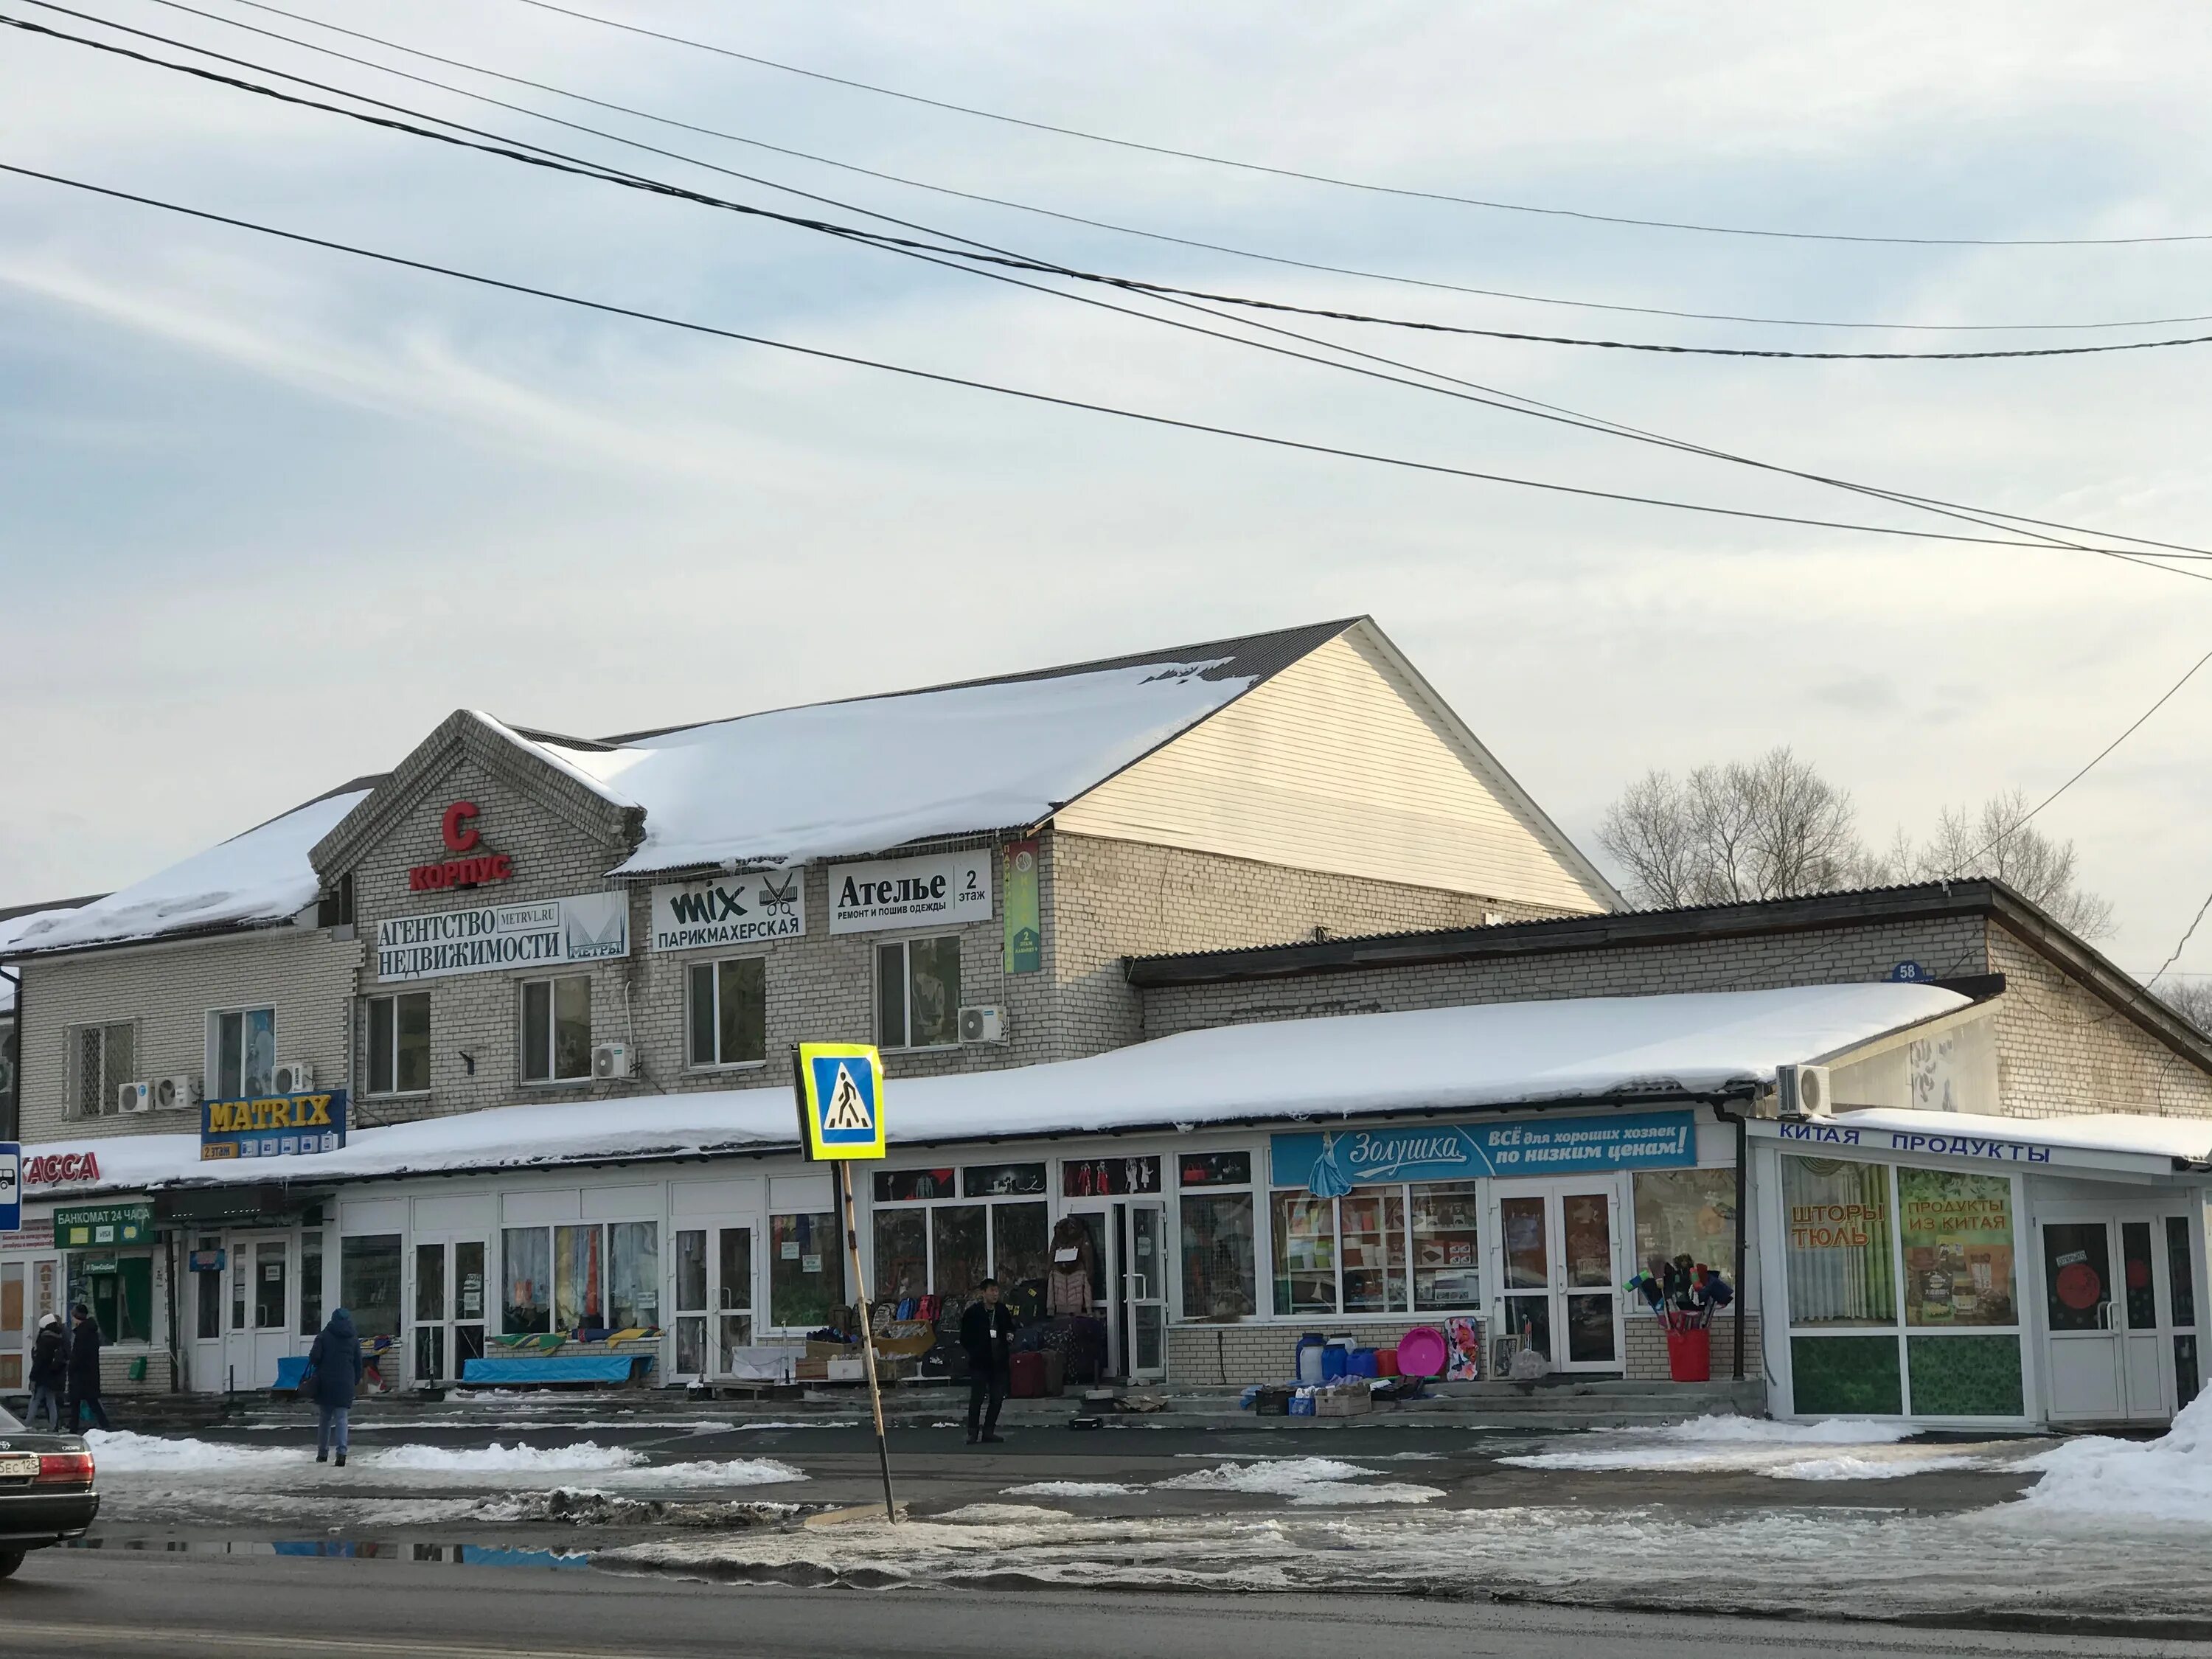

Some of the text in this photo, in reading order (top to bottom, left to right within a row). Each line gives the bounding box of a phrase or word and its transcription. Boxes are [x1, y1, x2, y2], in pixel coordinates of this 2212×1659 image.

[442, 801, 481, 852] С
[409, 855, 512, 891] КОРПУС
[838, 875, 946, 908] Ателье
[959, 870, 985, 902] 2 этаж
[501, 908, 554, 925] METRVL.RU
[838, 902, 946, 919] РЕМОНТ И ПОШИВ ОДЕЖДЫ
[378, 909, 495, 947] АГЕНТСТВО
[658, 917, 799, 948] ПАРИКМАХЕРСКАЯ
[1023, 931, 1029, 940] 2
[378, 932, 560, 978] НЕДВИЖИМОСТИ
[571, 943, 621, 958] МЕТРЫ
[1900, 964, 1916, 978] 58
[209, 1095, 331, 1133] MATRIX
[1488, 1126, 1676, 1147] ВСЁ для хороших хозяек
[1496, 1126, 1688, 1164] по низким ценам!
[1780, 1123, 2050, 1163] КИТАЯ ПРОДУКТЫ
[204, 1147, 210, 1158] 2
[1349, 1133, 1462, 1177] Золушка
[58, 1208, 150, 1225] БАНКОМАТ 24 ЧАСА
[1792, 1203, 1885, 1225] ШТОРЫ
[1908, 1200, 2004, 1214] ПРОДУКТЫ
[1909, 1215, 2006, 1231] ИЗ КИТАЯ
[1792, 1227, 1870, 1248] ТЮЛЬ
[21, 1460, 36, 1470] 125
